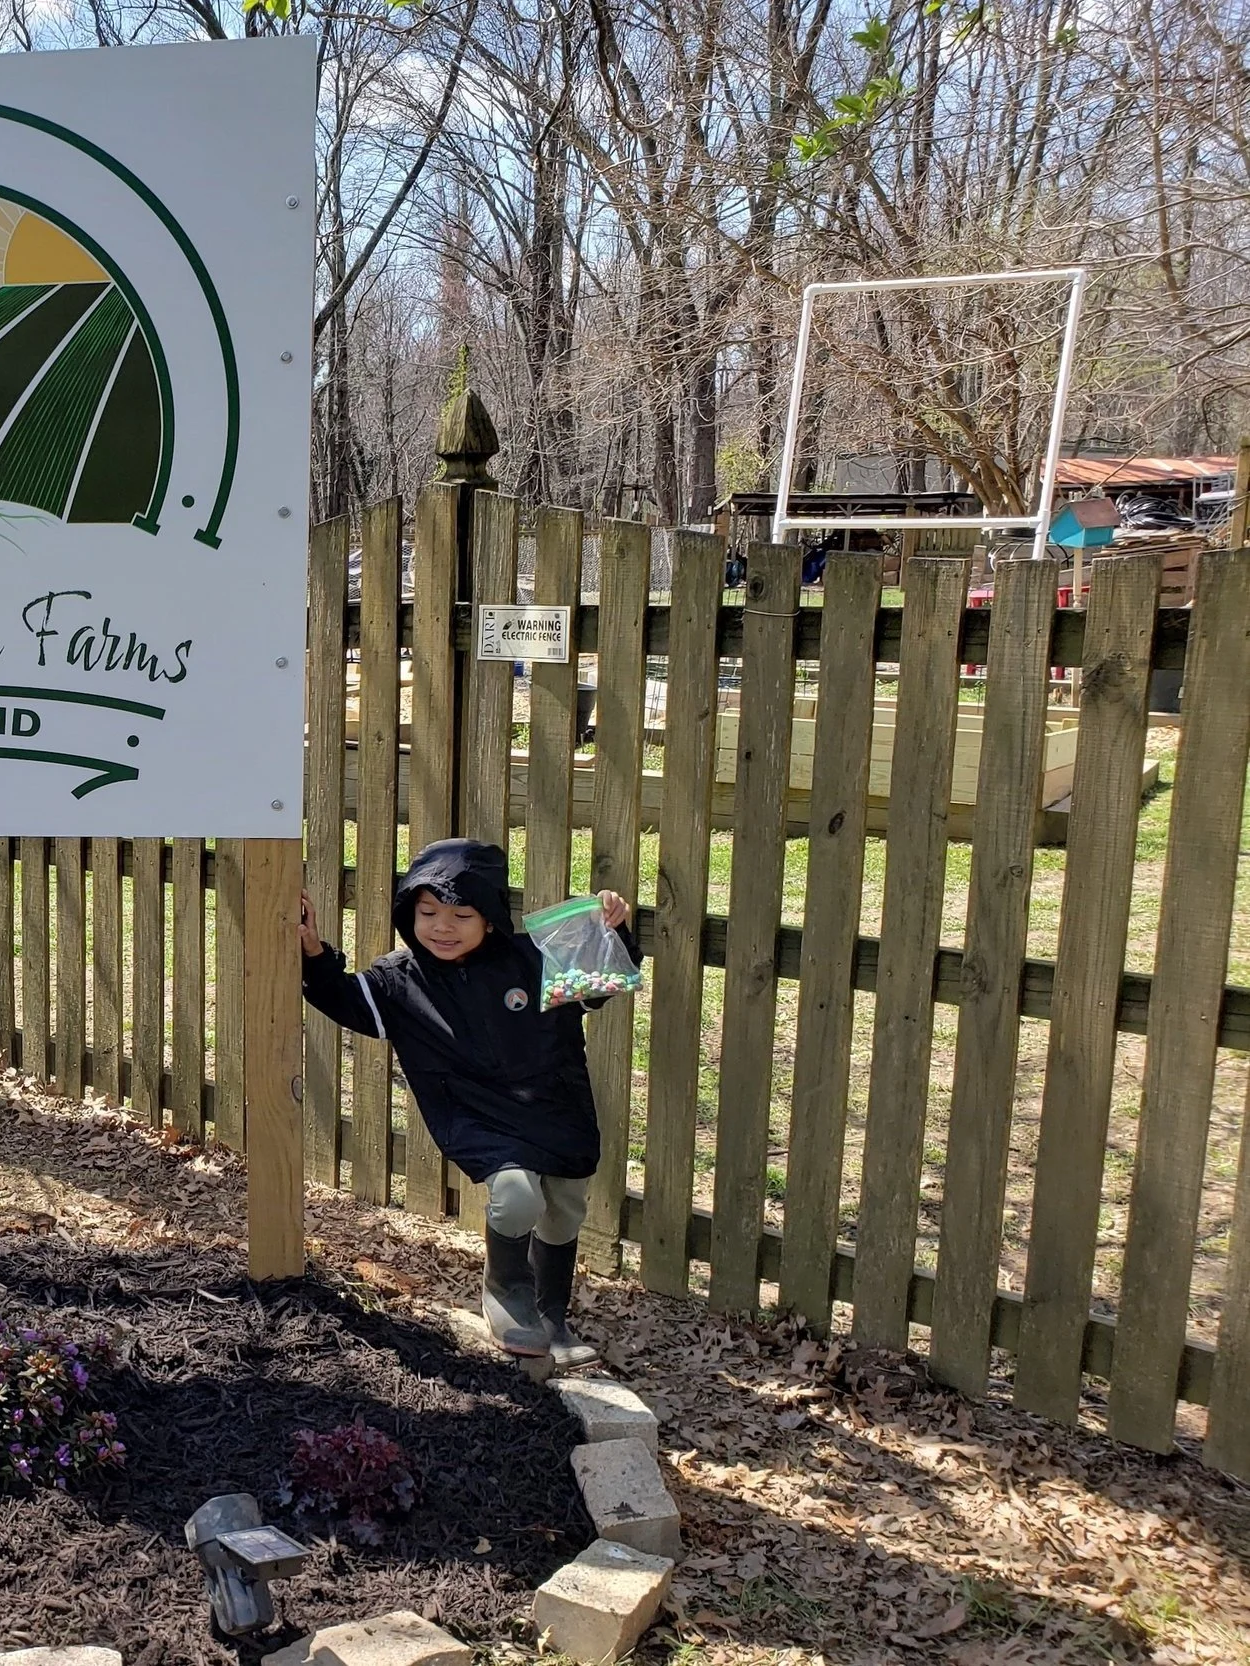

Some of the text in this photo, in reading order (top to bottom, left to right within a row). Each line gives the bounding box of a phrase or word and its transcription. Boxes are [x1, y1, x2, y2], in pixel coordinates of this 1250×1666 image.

[517, 619, 561, 632] WARNING
[21, 589, 193, 684] Farms
[501, 631, 561, 642] ELECTRIC FENCE
